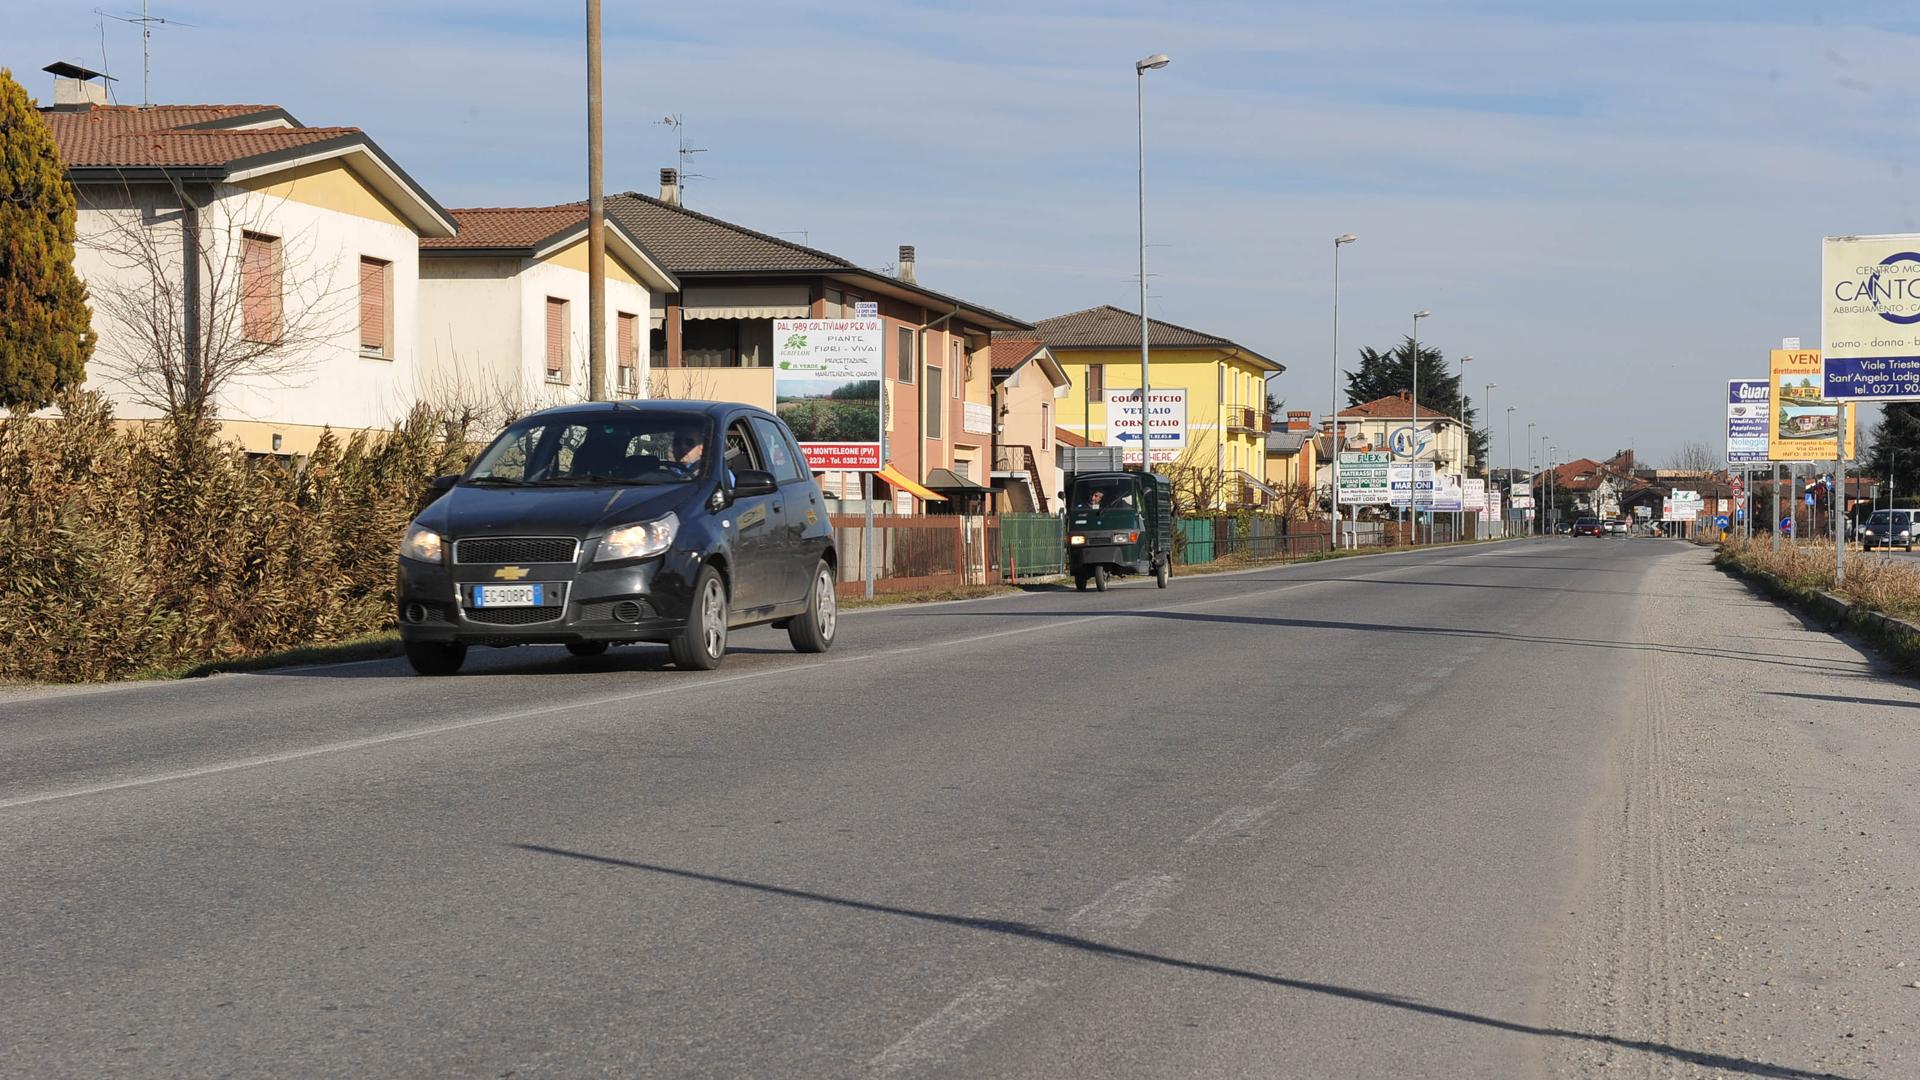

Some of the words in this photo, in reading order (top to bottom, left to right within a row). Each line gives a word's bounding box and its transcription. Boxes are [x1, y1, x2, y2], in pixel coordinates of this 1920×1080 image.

[1856, 265, 1899, 275] CENTRO
[1835, 278, 1920, 301] CANTO
[1833, 304, 1903, 314] ABBIGLIAMENTO
[777, 322, 790, 331] DAL
[793, 322, 807, 332] 1989
[809, 322, 848, 332] COLTIVIAMO
[850, 322, 864, 331] PER
[1870, 337, 1904, 347] donna
[1788, 354, 1818, 364] VEN
[1860, 360, 1885, 370] Viale
[1889, 360, 1920, 368] Trieste
[1829, 372, 1889, 384] Sant'Angelo
[1893, 371, 1920, 383] Lodig
[1855, 384, 1869, 394] tel.
[1872, 384, 1920, 394] 0371.90
[861, 448, 874, 456] (PV)
